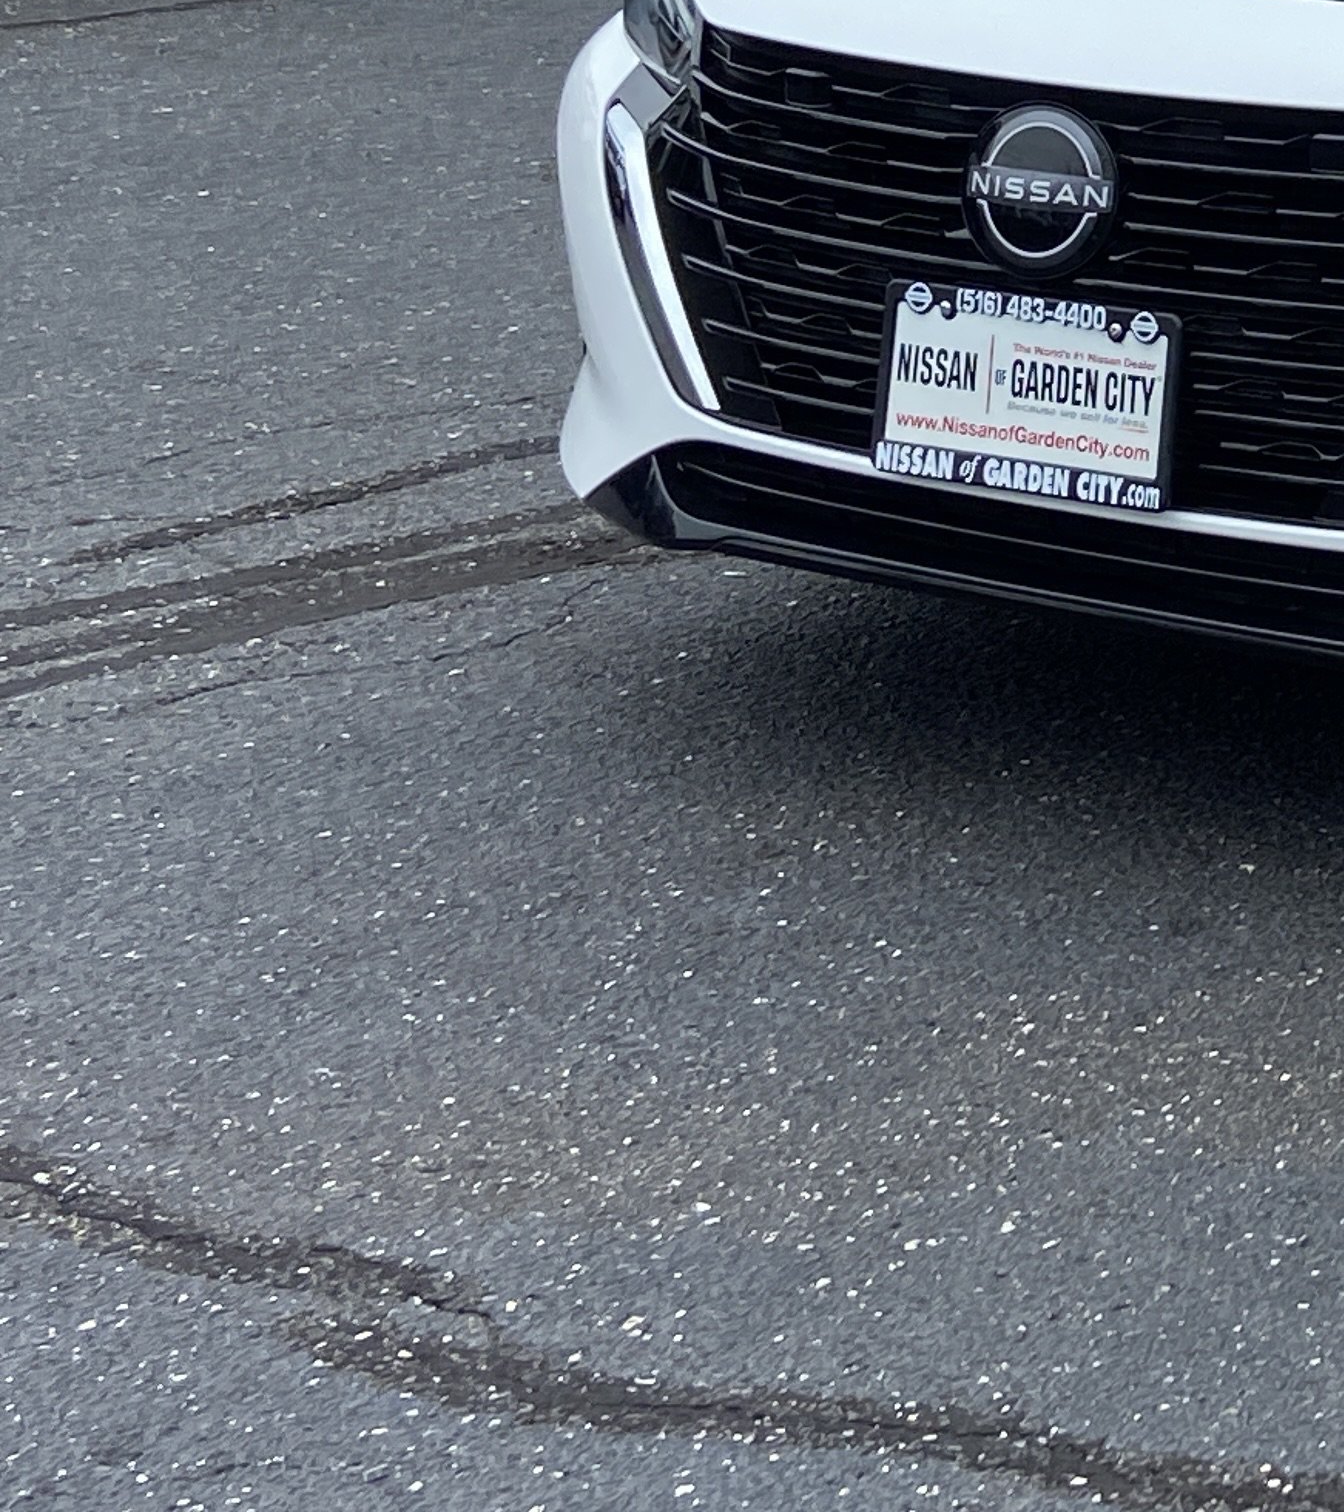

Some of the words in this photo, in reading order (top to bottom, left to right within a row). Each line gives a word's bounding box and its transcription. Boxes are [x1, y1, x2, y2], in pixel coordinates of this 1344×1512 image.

[971, 171, 1109, 208] NISSAN
[956, 288, 1003, 317] (516)
[1006, 295, 1107, 331] 483-4400
[897, 343, 978, 392] NISSAN
[1011, 359, 1099, 409] GARDEN
[1105, 372, 1156, 416] CITY
[1124, 357, 1157, 371] Dealer
[896, 413, 1150, 461] www.NissanofGardenCity.com
[1103, 413, 1119, 425] for
[875, 441, 955, 480] NISSAN
[959, 454, 982, 484] of
[983, 457, 1070, 497] GARDEN
[1076, 471, 1160, 509] CITY.com
